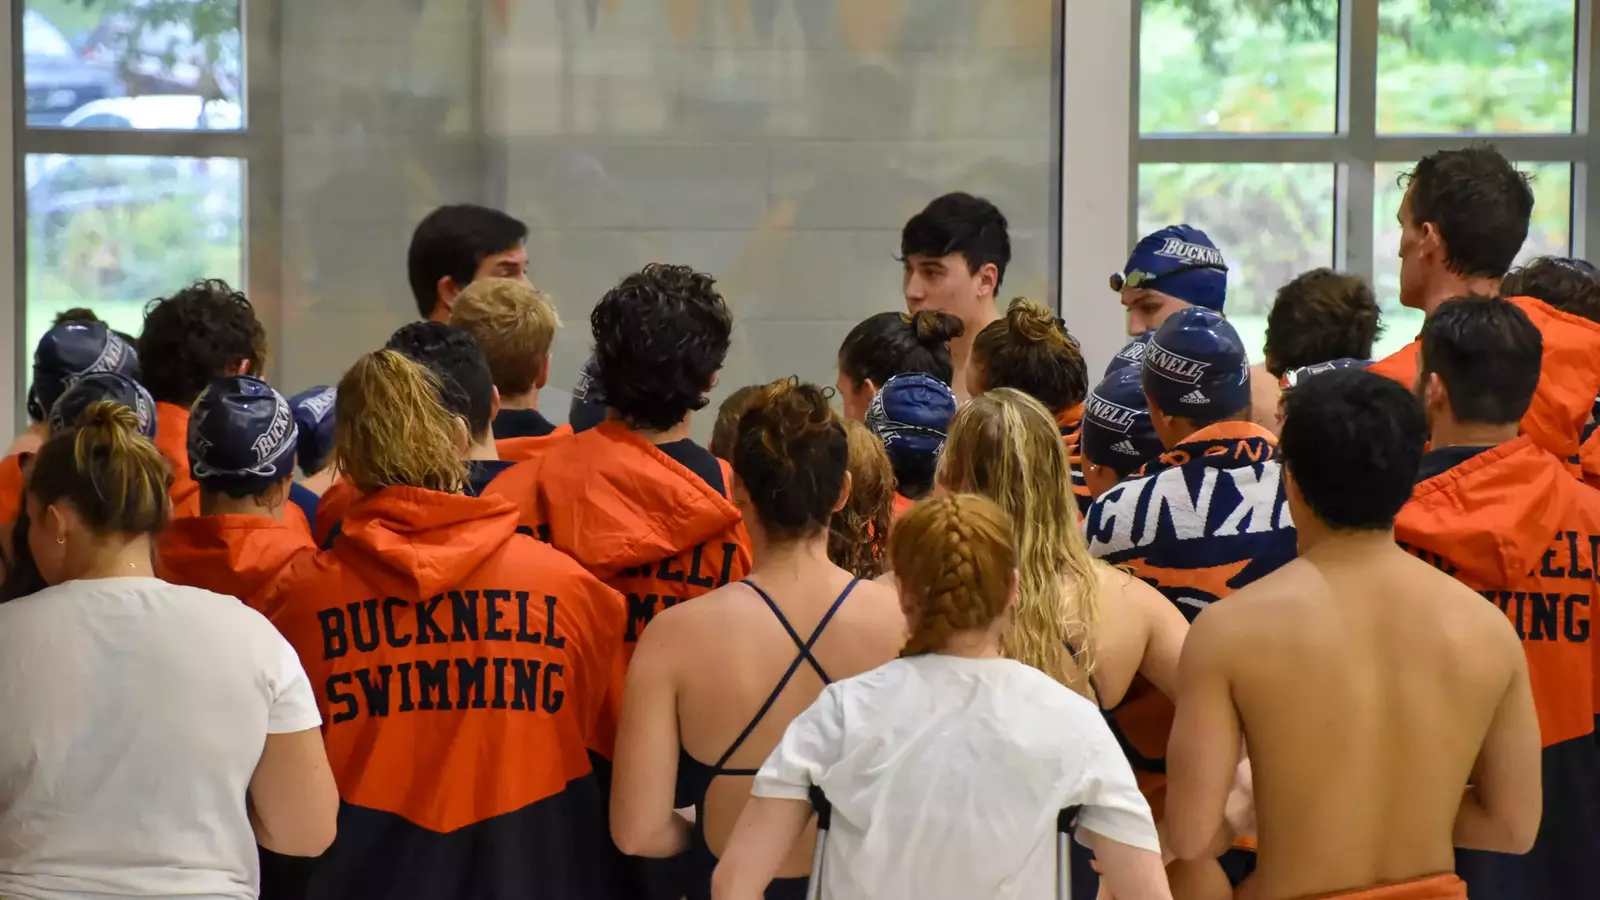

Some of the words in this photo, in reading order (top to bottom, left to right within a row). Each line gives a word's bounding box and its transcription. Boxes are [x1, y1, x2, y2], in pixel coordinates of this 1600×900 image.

[1145, 343, 1201, 378] CKNELL
[257, 401, 291, 460] BUCKN
[1086, 396, 1131, 426] KNELL
[317, 588, 567, 661] BUCKNELL
[325, 656, 565, 725] SWIMMING
